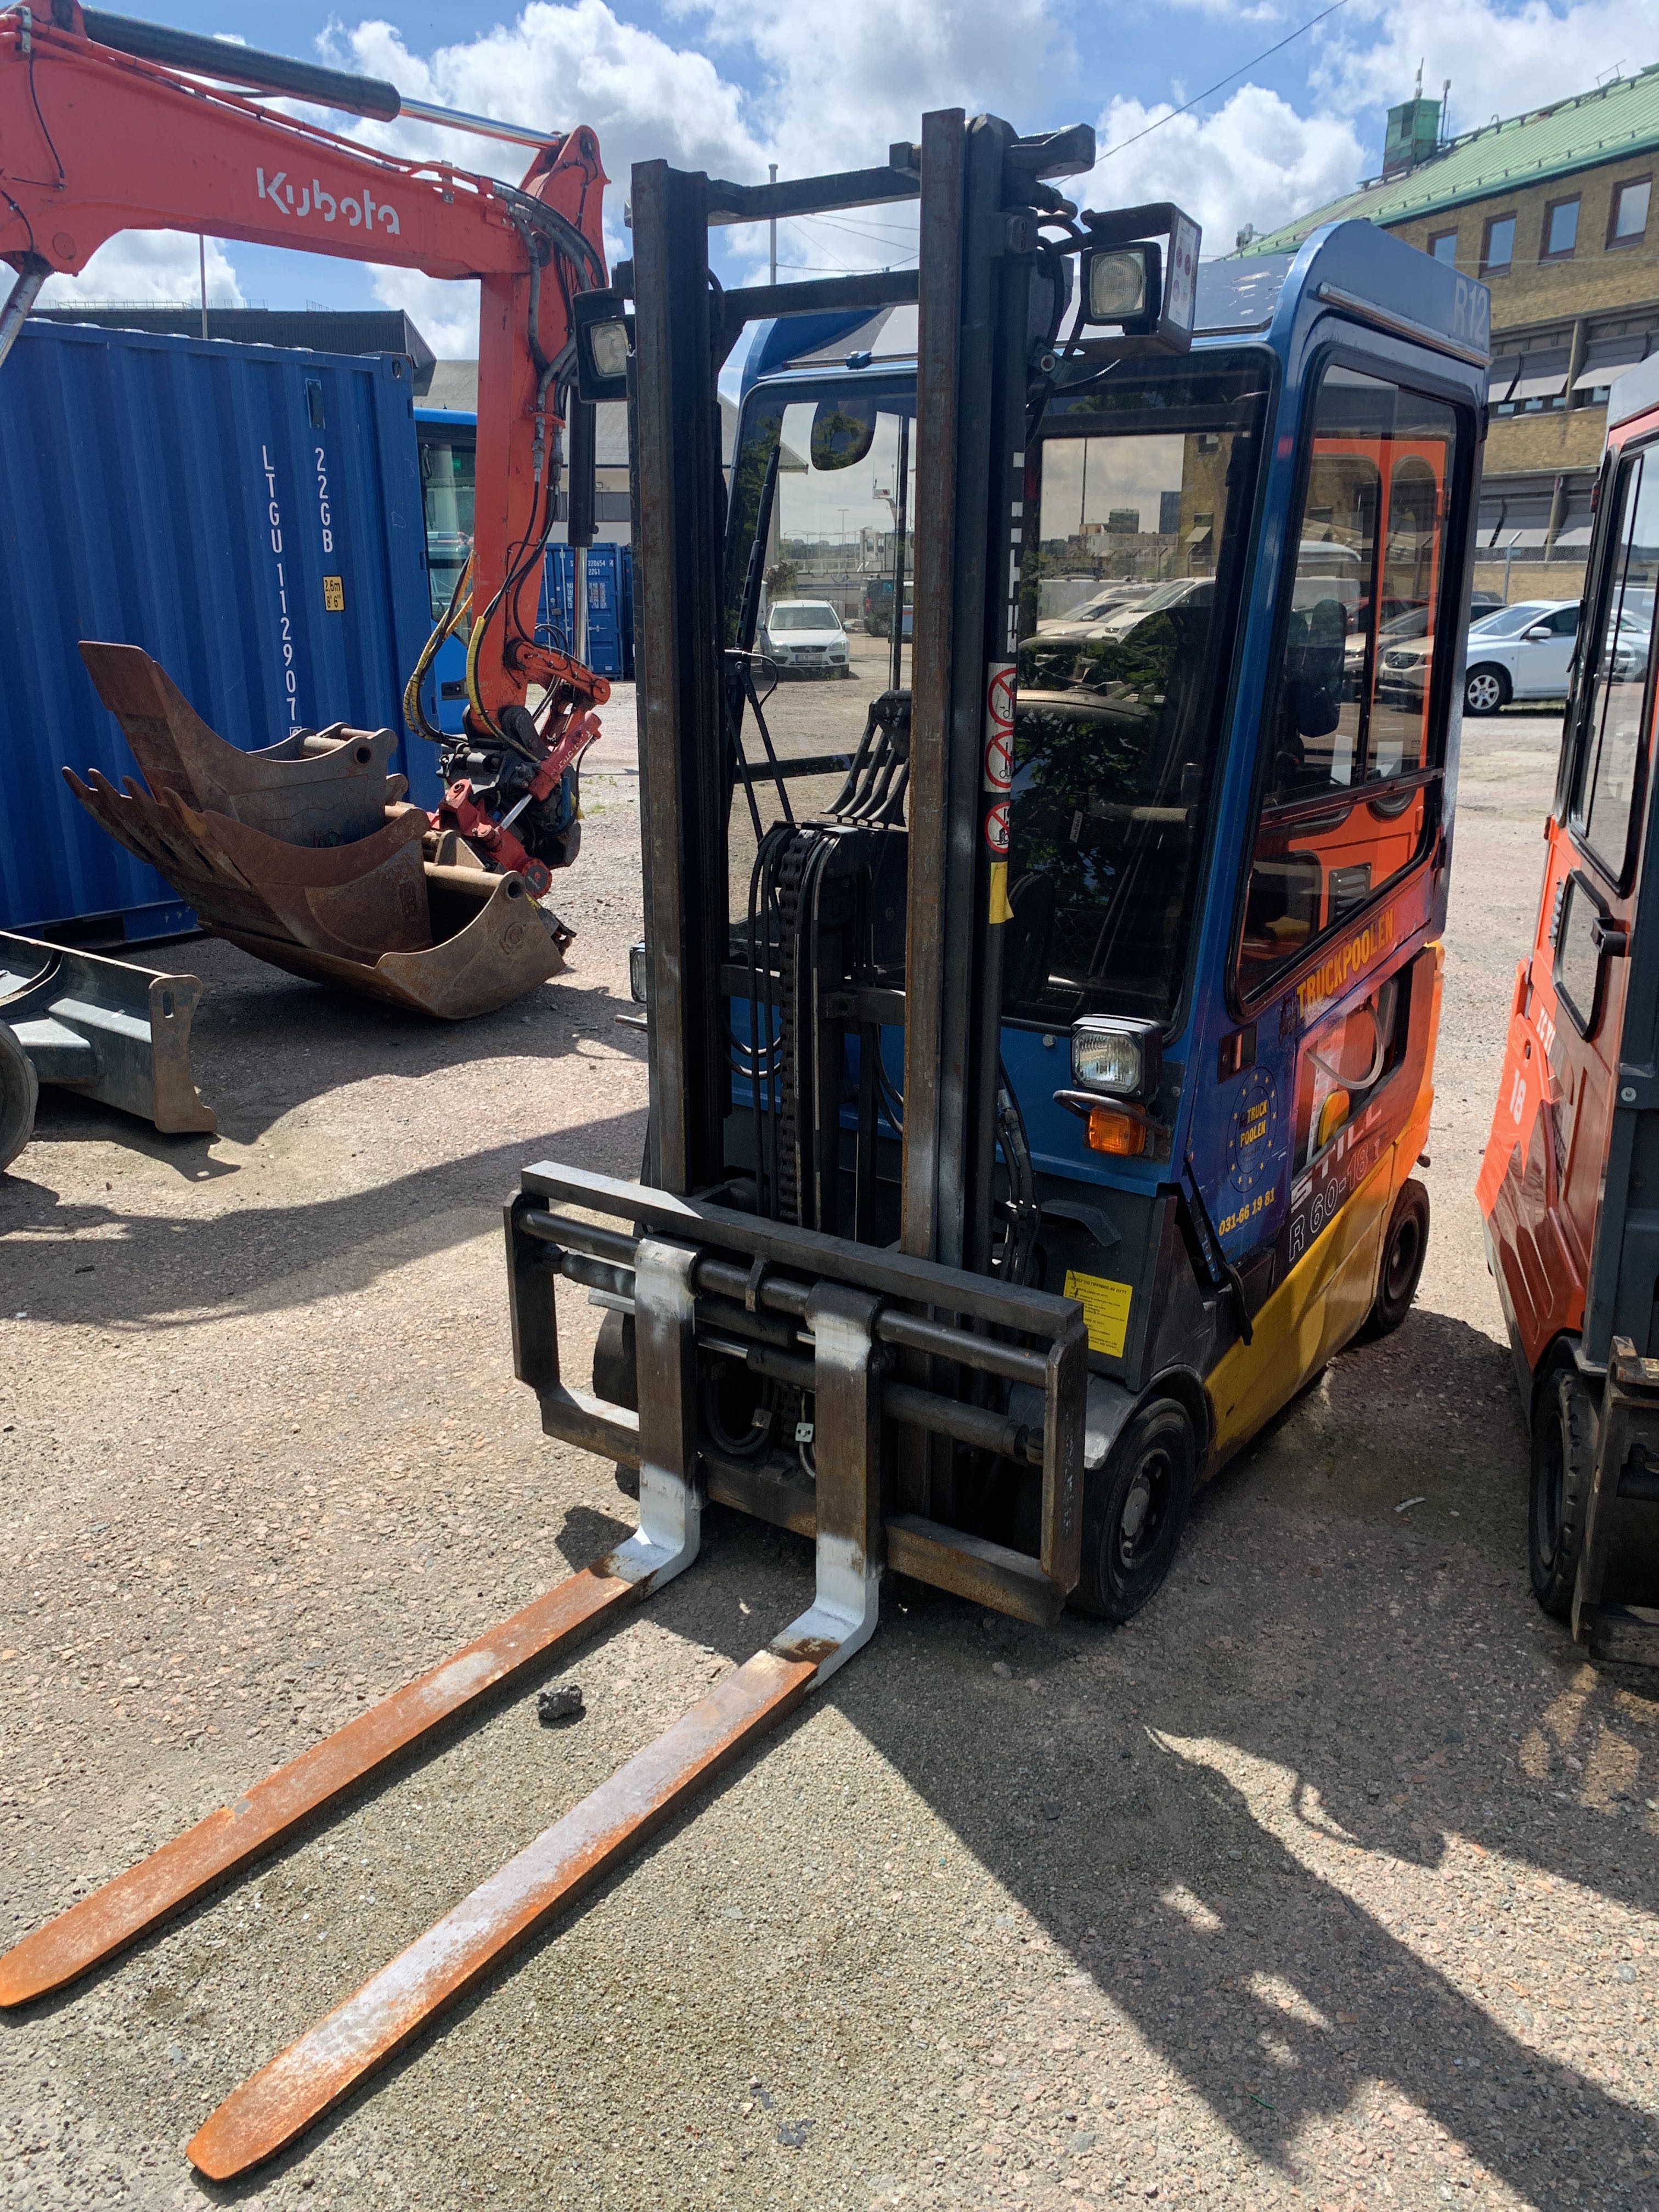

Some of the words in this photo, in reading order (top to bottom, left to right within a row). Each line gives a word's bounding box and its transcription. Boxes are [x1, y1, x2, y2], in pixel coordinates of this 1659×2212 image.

[256, 167, 400, 234] Kubota
[1453, 277, 1488, 343] R12
[315, 447, 333, 552] 22GB
[262, 445, 283, 553] LTGU
[276, 563, 296, 720] 112907
[1296, 907, 1394, 1019] TRUCKPOOLEN
[1247, 1099, 1268, 1122] TRUCK
[1509, 1068, 1526, 1126] 18
[1240, 1120, 1266, 1148] POOLEN
[1290, 1103, 1382, 1214] STILL
[1218, 1206, 1250, 1237] 031-66
[1252, 1195, 1263, 1215] 19
[1289, 1214, 1305, 1263] R
[1310, 1142, 1368, 1234] 60-18
